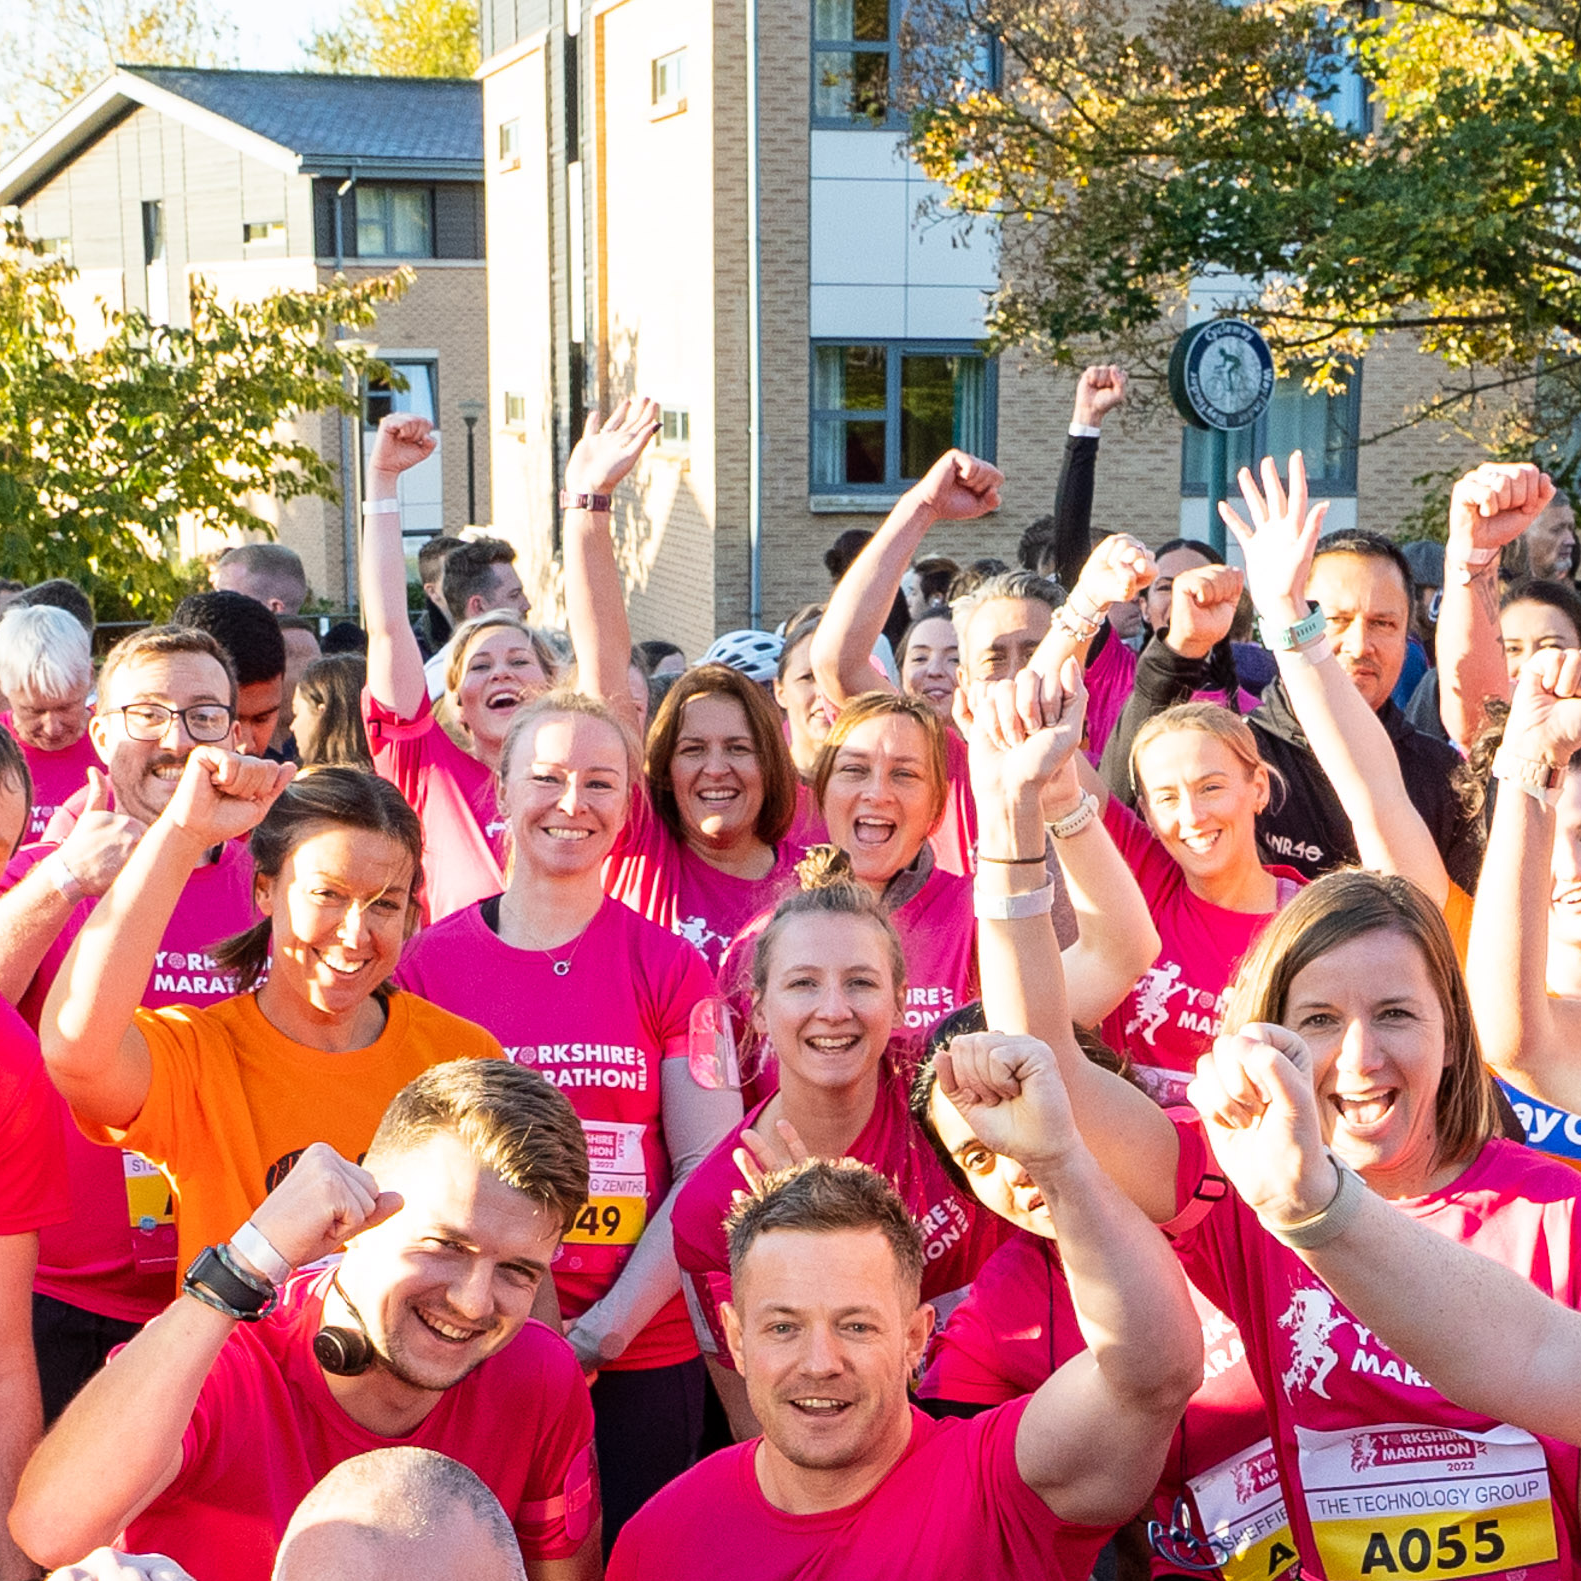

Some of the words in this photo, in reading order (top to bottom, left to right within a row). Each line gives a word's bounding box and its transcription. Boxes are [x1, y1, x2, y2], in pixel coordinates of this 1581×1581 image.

[542, 1068, 637, 1090] RATHON
[637, 1048, 648, 1092] RELAY
[575, 1205, 621, 1237] 49
[1382, 1442, 1471, 1461] MARATHON
[1447, 1461, 1475, 1472] 2022
[1317, 1497, 1351, 1516] THE
[1353, 1487, 1470, 1514] TECHNOLOGY
[1474, 1480, 1540, 1503] GROUP
[1360, 1519, 1506, 1576] A055
